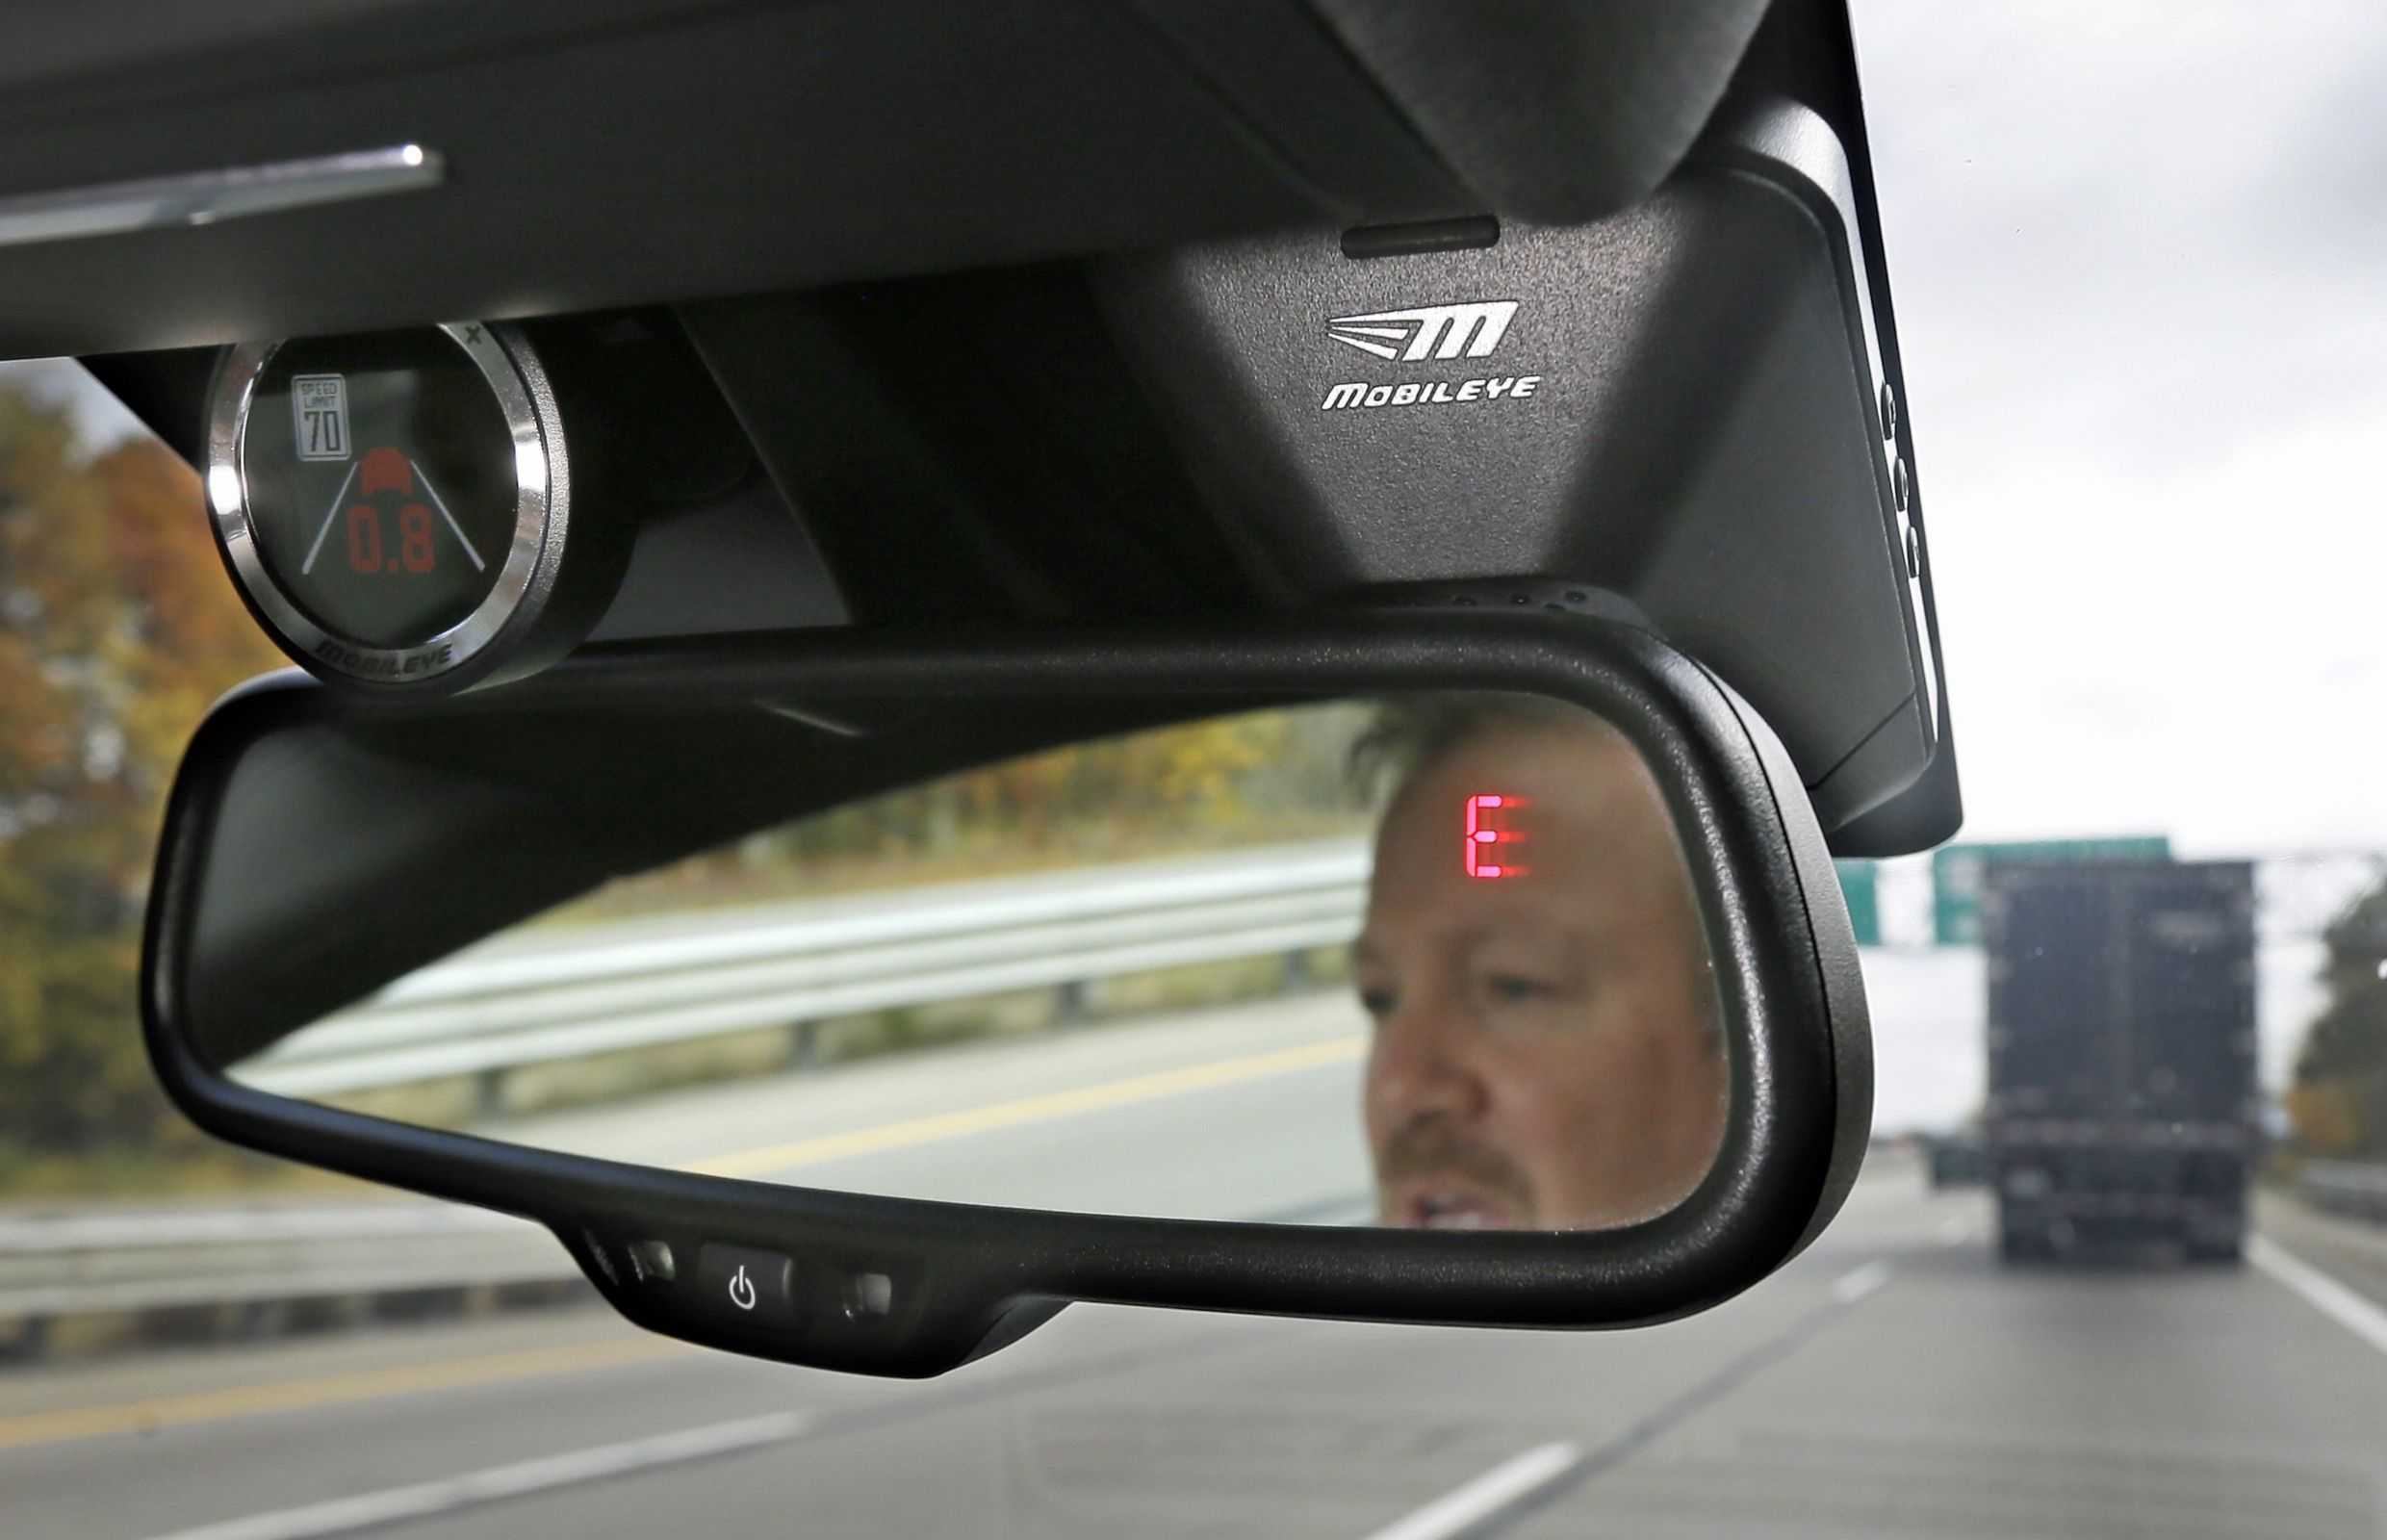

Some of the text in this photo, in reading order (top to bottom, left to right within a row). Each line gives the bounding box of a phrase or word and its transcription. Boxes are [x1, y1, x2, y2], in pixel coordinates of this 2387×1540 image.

[301, 383, 338, 396] SPEED
[303, 396, 338, 408] LIMIT
[1321, 375, 1541, 411] MOBILEYE
[304, 410, 341, 452] 70
[347, 503, 435, 574] 0.8
[315, 638, 452, 675] MOBILEYE
[1464, 794, 1507, 879] E
